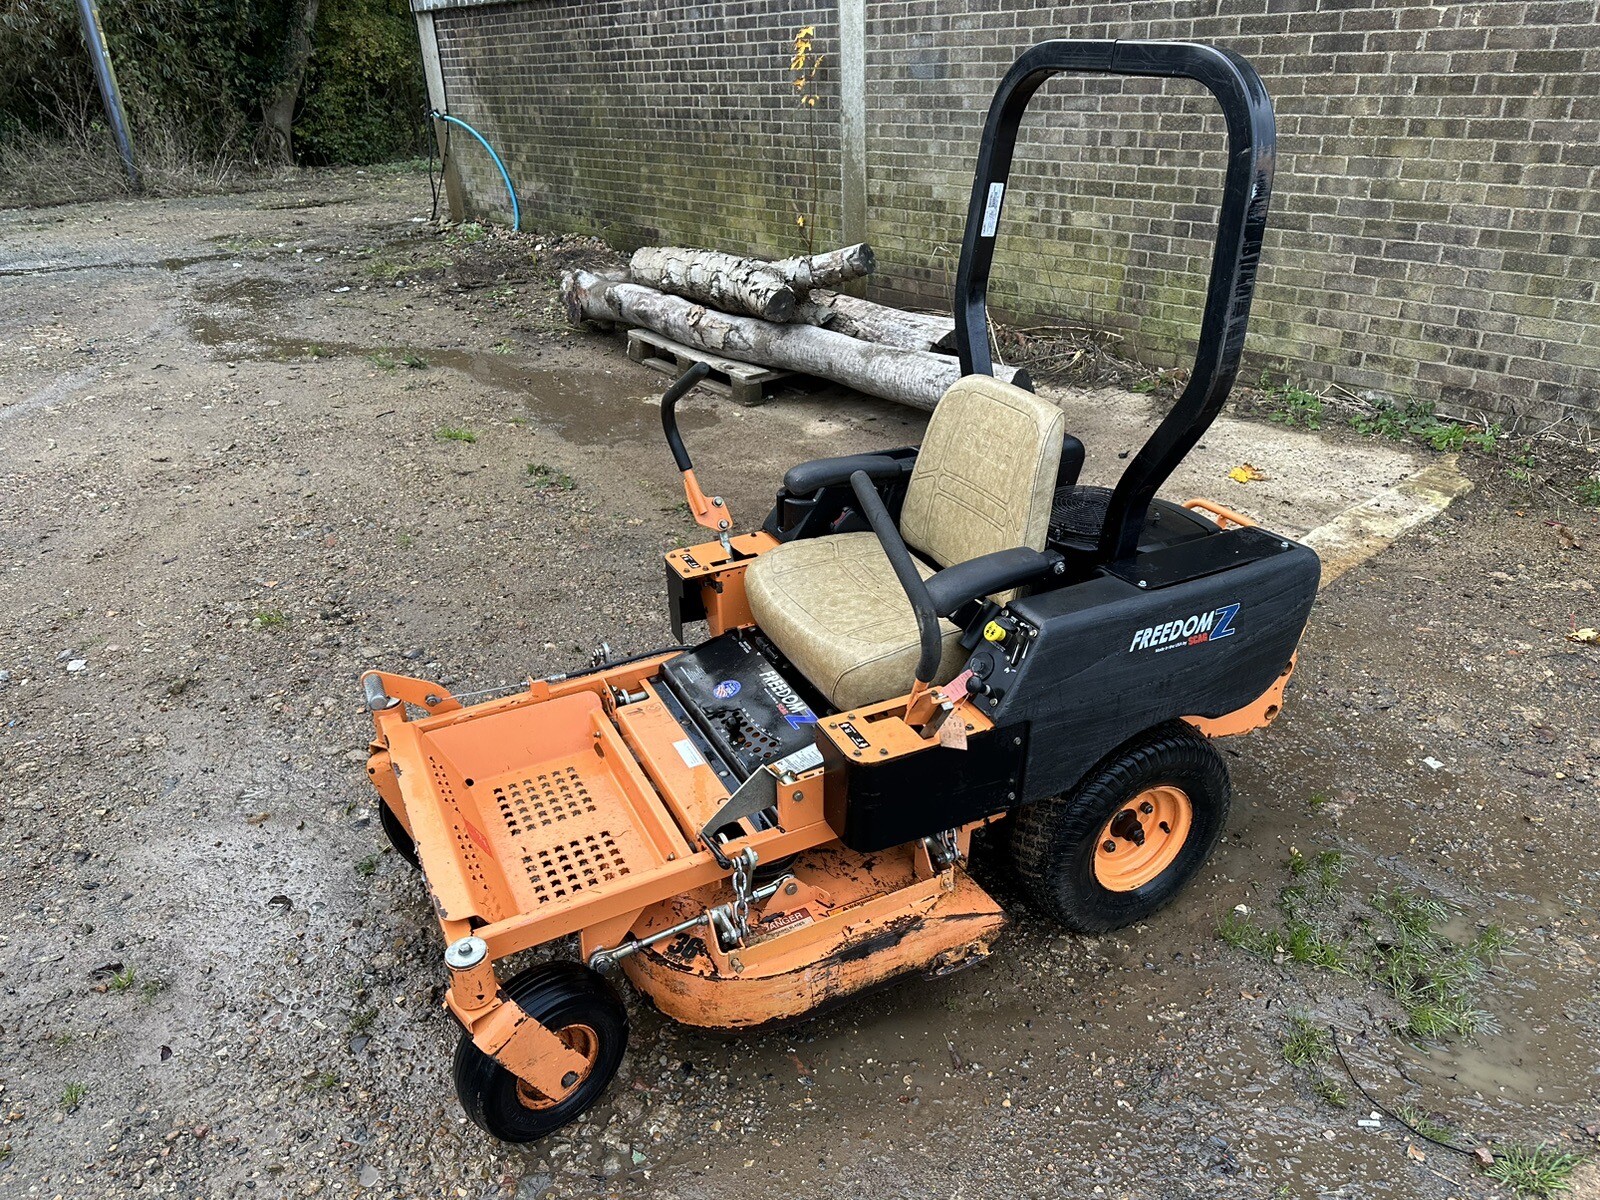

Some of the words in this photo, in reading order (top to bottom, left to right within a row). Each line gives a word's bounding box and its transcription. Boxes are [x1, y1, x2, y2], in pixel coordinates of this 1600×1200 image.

[1129, 610, 1215, 653] FREEDOM
[1208, 602, 1241, 641] Z
[759, 670, 807, 713] FREEDOM
[784, 708, 819, 731] Z
[667, 932, 703, 959] 36
